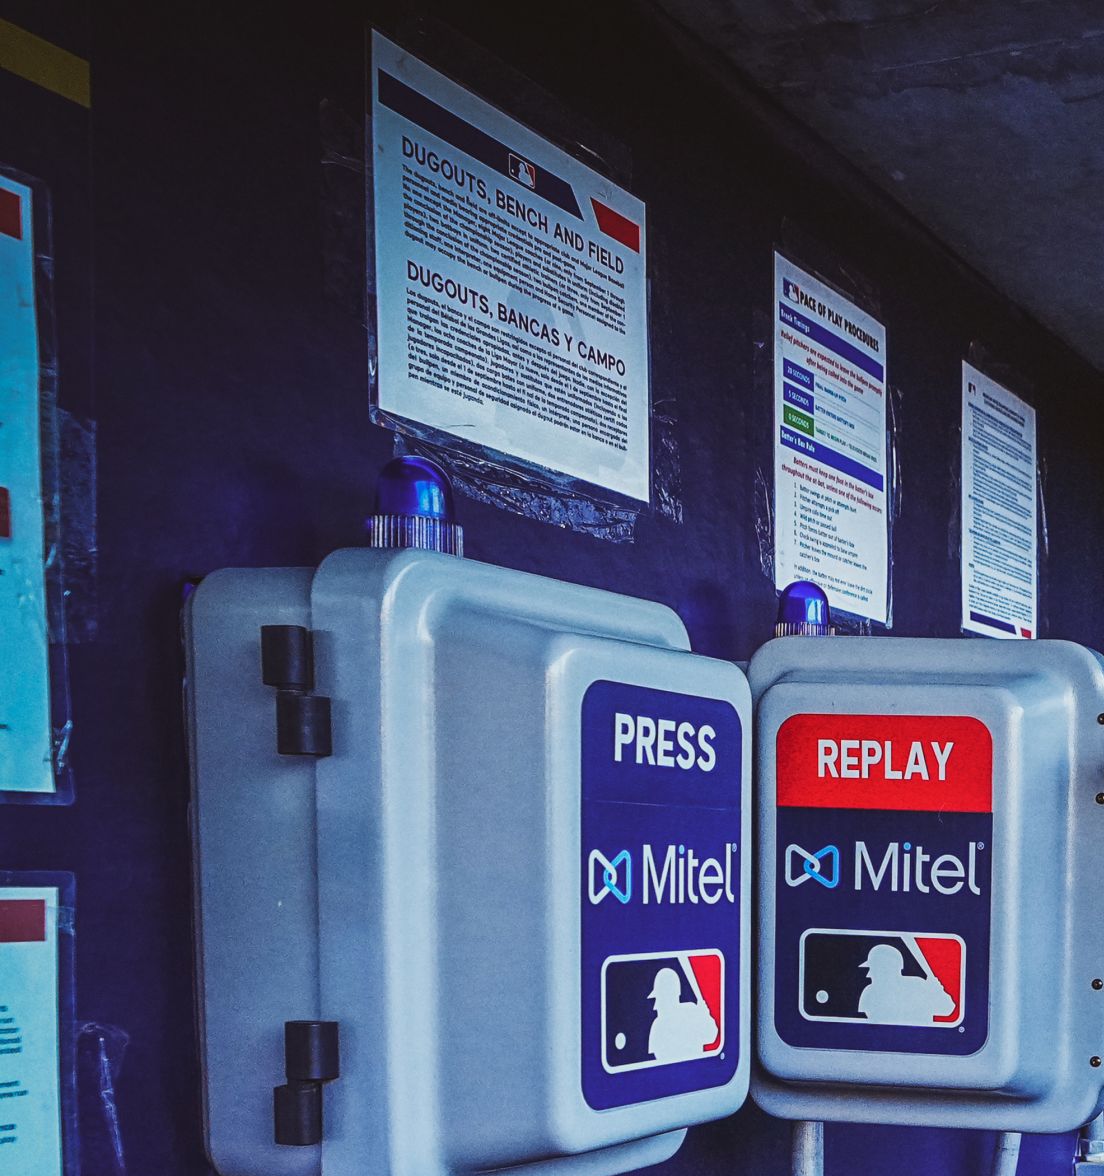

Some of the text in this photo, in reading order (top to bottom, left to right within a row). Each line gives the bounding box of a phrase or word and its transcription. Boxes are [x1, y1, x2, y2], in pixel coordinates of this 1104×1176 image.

[402, 136, 624, 273] DUGOUTS, BENCH AND FIELD
[407, 261, 626, 375] DUGOUTS, BANCAS Y CAMPO
[800, 291, 879, 352] PACE OF PLAY PROCEDURES
[613, 712, 717, 772] PRESS
[816, 738, 954, 782] REPLAY
